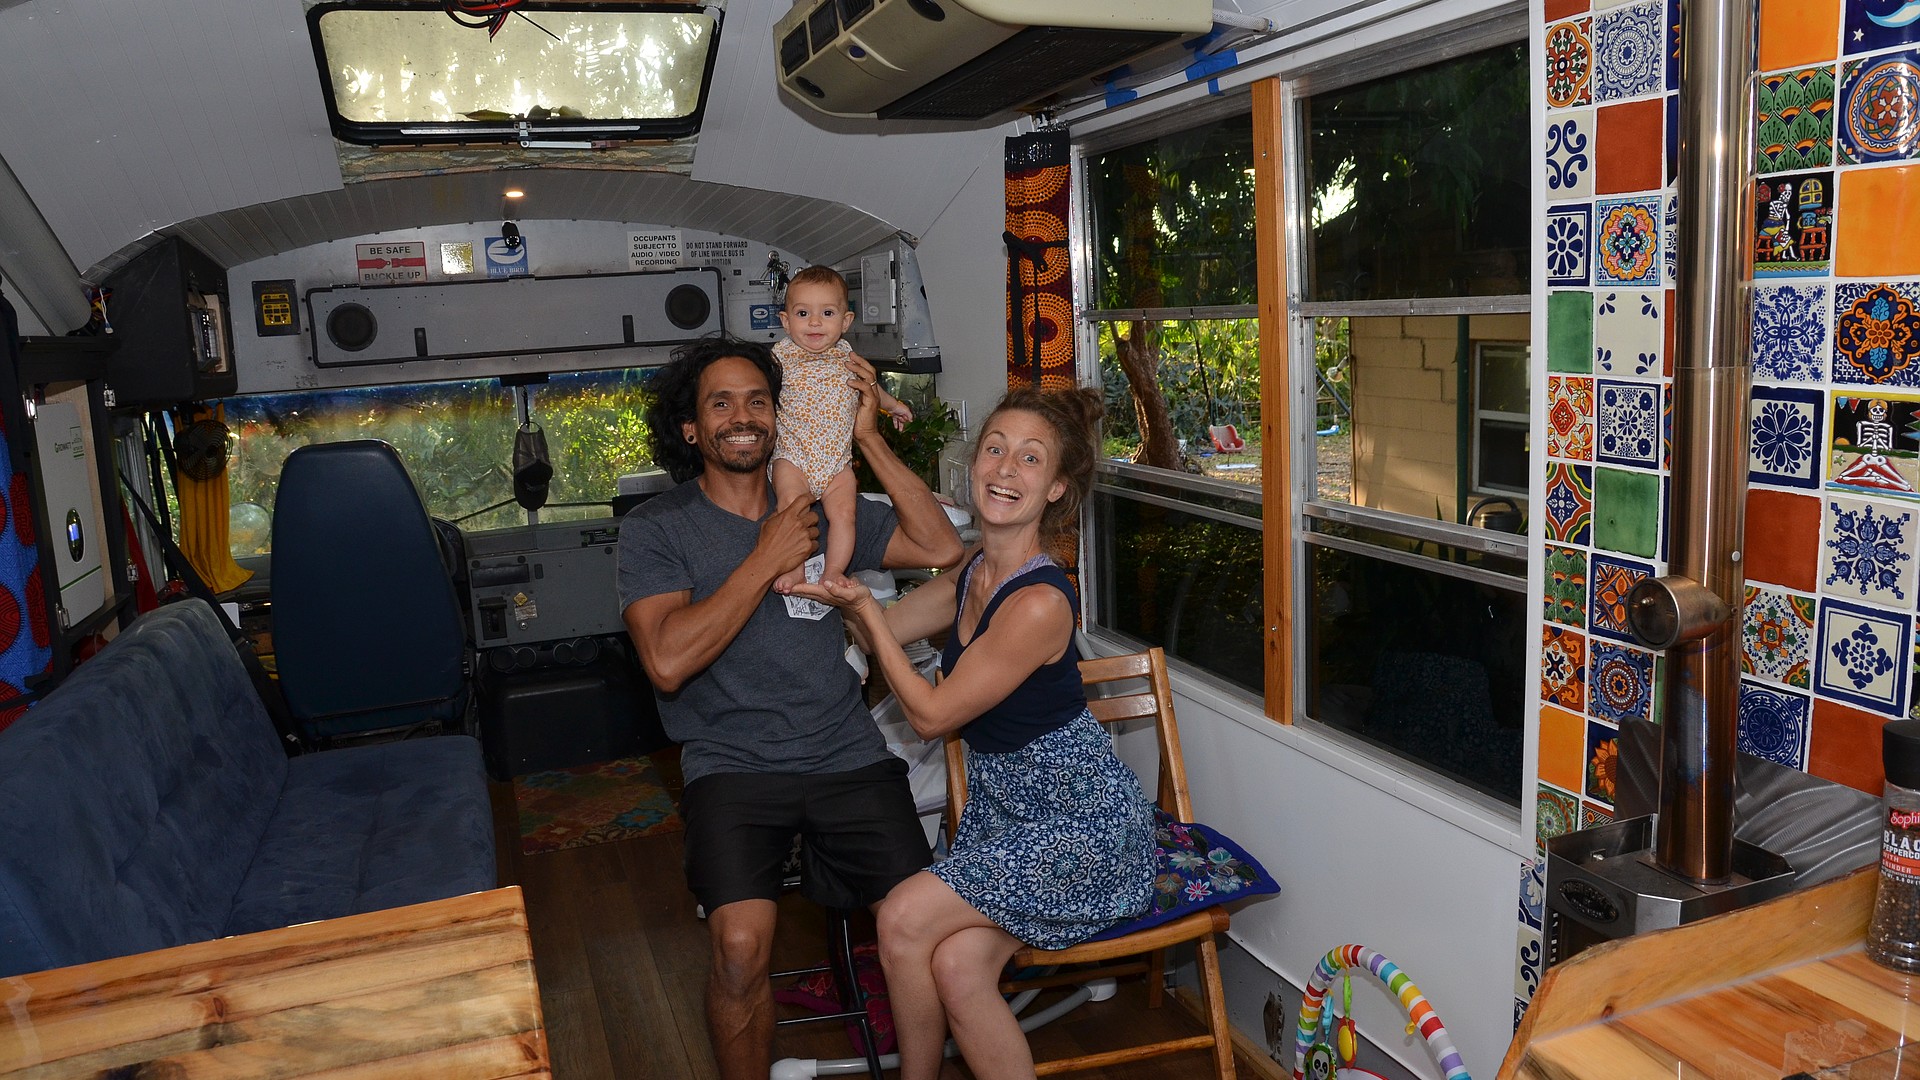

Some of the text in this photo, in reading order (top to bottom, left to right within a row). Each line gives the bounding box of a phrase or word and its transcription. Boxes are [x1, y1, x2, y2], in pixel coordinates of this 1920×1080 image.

[686, 242, 694, 250] DO
[705, 241, 722, 249] STAND
[369, 246, 411, 255] BE SAFE
[690, 250, 698, 258] OF
[699, 250, 710, 258] LINE
[635, 258, 677, 266] RECORDING
[364, 271, 421, 281] BUCKLE UP
[1883, 851, 1899, 863] WITH
